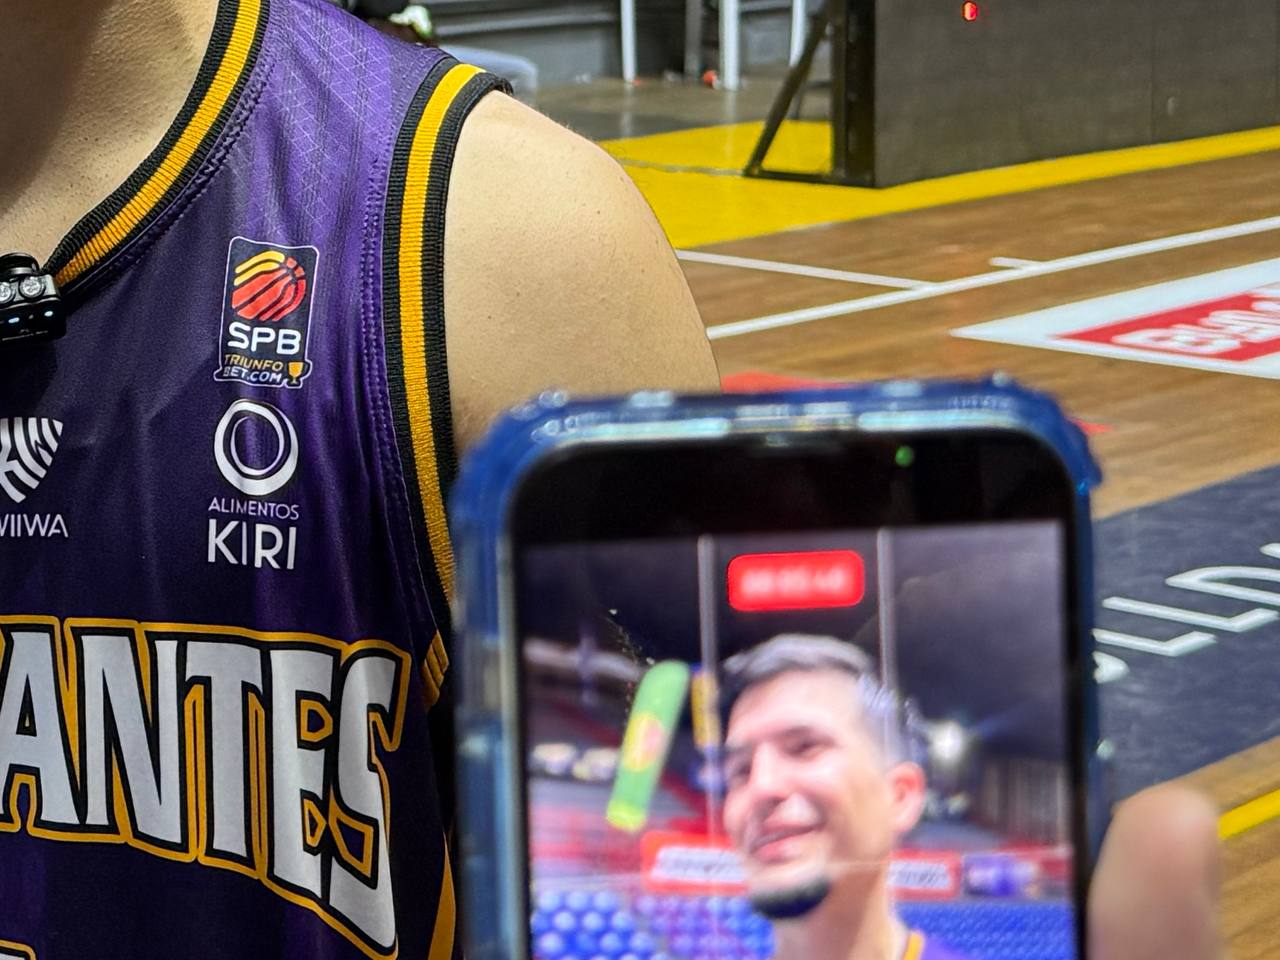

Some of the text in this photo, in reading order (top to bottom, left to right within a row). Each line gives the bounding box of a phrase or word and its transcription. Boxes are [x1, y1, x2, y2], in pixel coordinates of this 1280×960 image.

[227, 321, 302, 356] SPB
[222, 365, 283, 384] BET.COM
[224, 353, 284, 372] TRIUNFO
[207, 496, 300, 520] ALIMENTOS
[207, 518, 298, 571] KIRI
